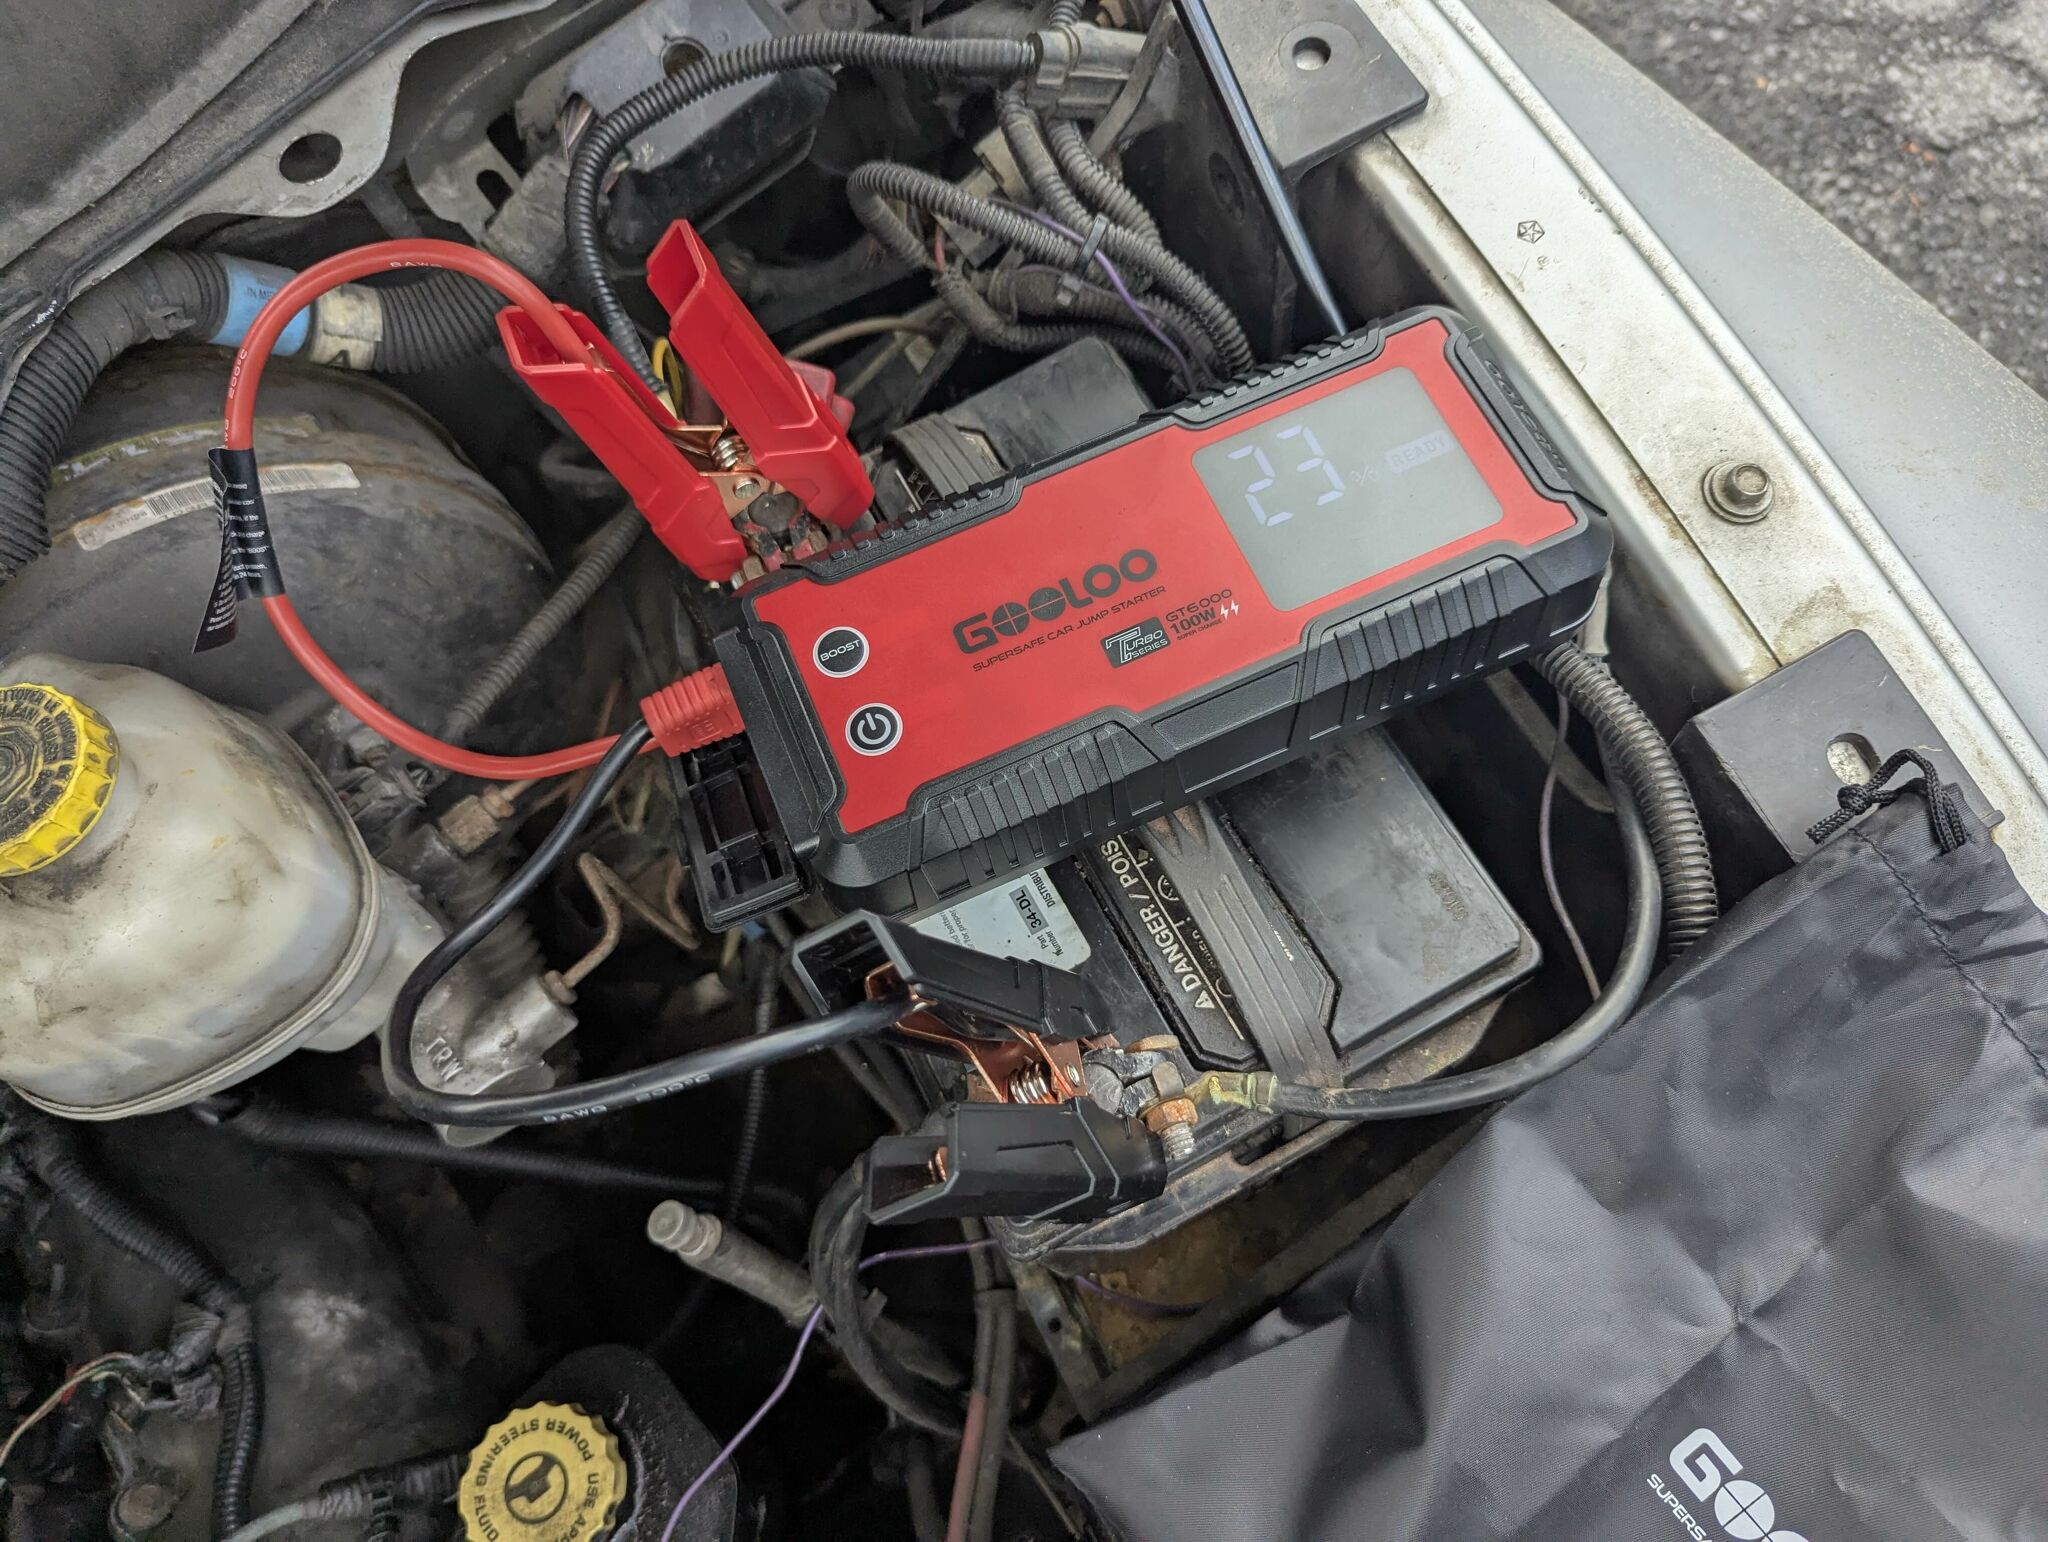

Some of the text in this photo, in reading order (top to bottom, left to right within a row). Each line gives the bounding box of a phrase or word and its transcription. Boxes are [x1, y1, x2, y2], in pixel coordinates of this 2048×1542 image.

[1390, 434, 1447, 469] READY
[1227, 424, 1346, 527] 23
[951, 547, 1158, 655] GOOLOO
[1165, 588, 1232, 623] GT6000
[1169, 606, 1216, 634] 100W
[972, 585, 1167, 672] SUPERSAFE CAR JUMP STARTER
[1105, 625, 1163, 664] TURBO
[820, 638, 861, 663] BOOST
[1130, 638, 1168, 658] SERIES
[1101, 839, 1139, 888] POIS
[1029, 871, 1056, 908] DISTRIBU
[949, 909, 968, 932] proper
[1015, 889, 1042, 929] 34-DL
[1036, 934, 1049, 950] Part
[1045, 930, 1064, 957] Number
[1139, 903, 1202, 992] DANGER
[473, 1417, 596, 1542] POWER STEERING FLUID
[583, 1472, 600, 1509] USE
[1669, 1427, 1809, 1542] GO
[1646, 1472, 1712, 1542] SUPERS
